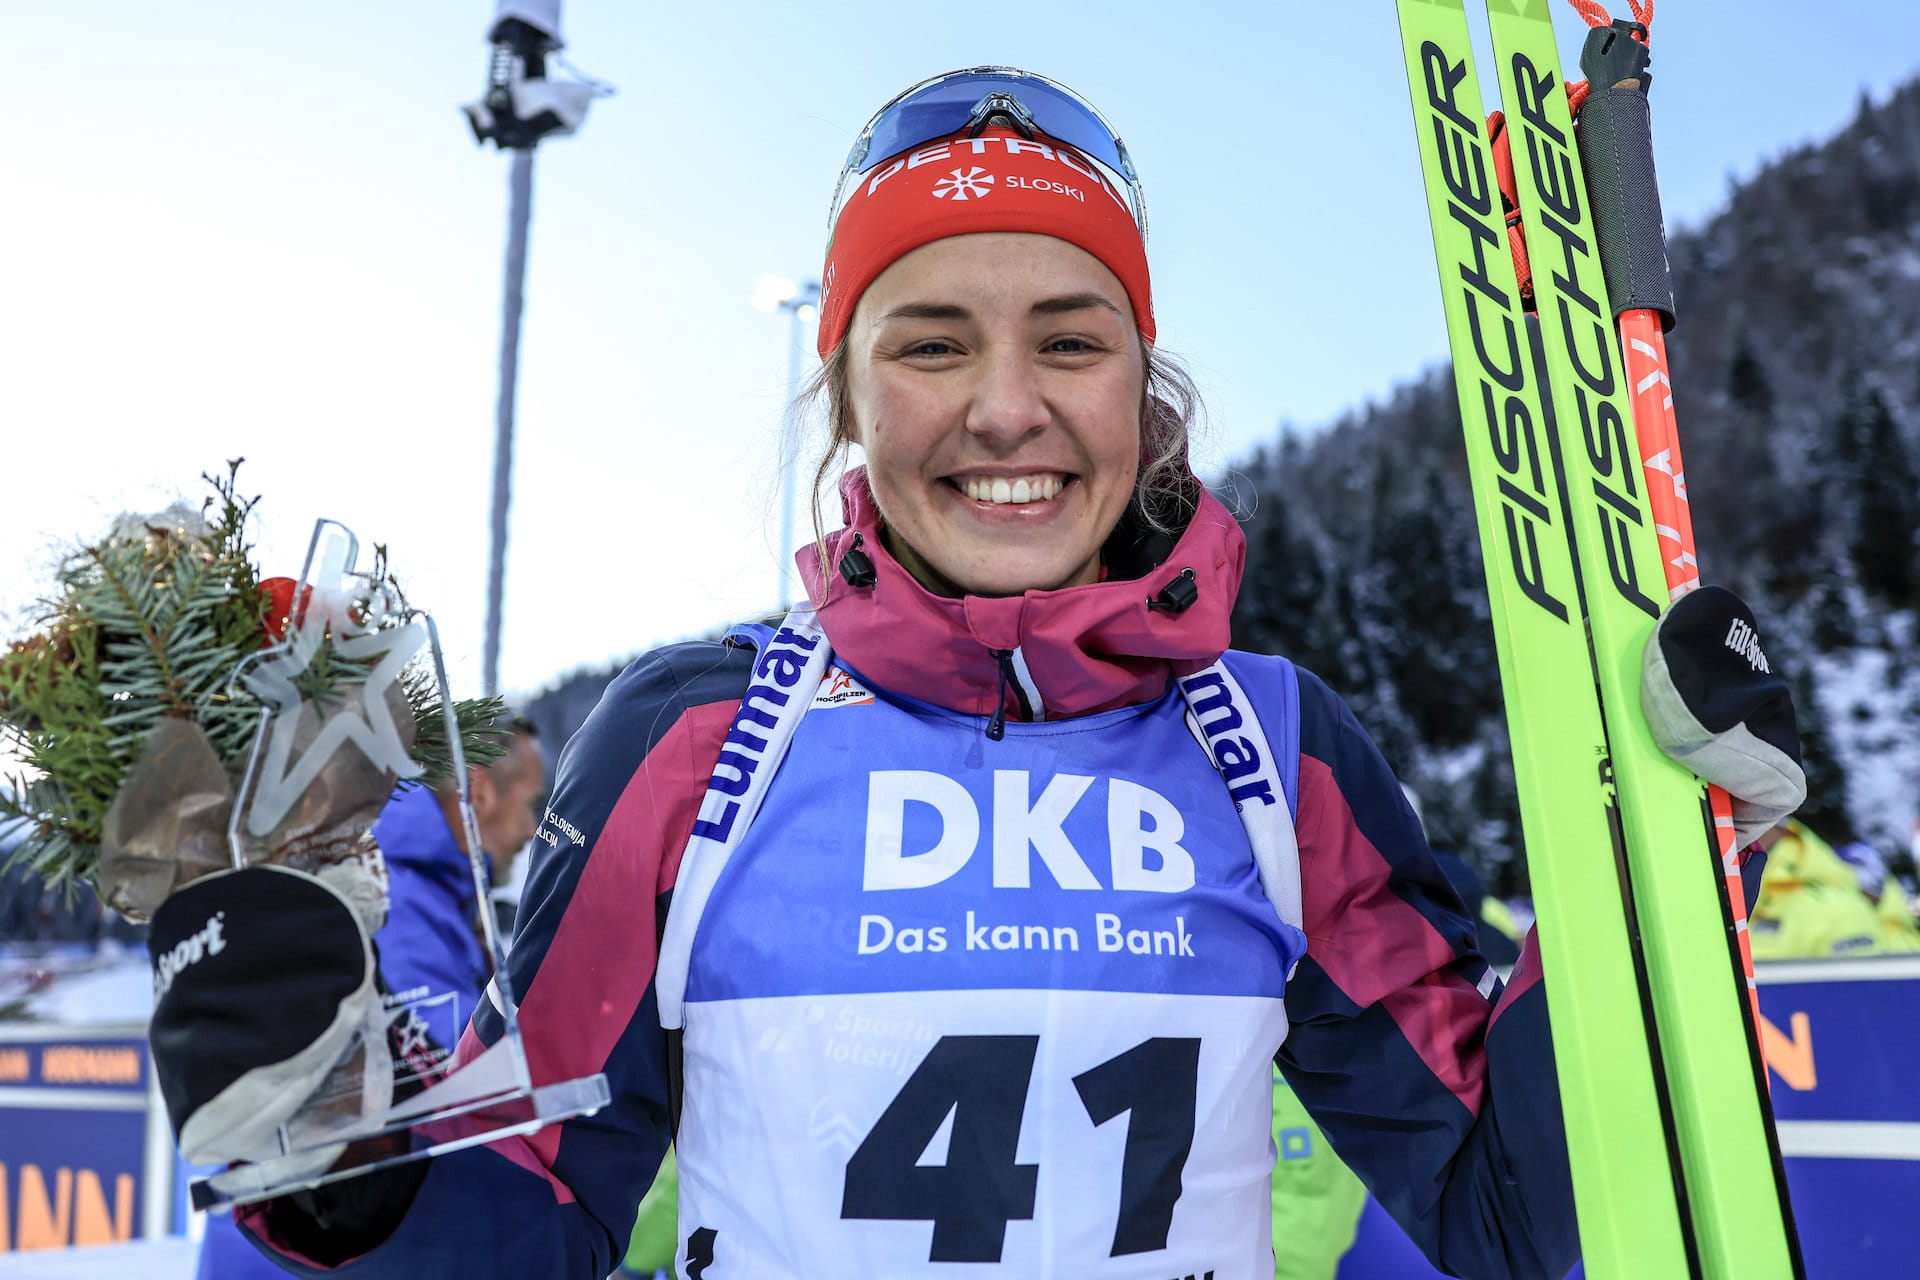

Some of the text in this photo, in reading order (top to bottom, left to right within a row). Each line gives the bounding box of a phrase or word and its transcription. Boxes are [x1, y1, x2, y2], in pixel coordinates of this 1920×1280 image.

[1005, 175, 1085, 203] SLOSKI
[1421, 40, 1570, 625] FISCHER
[1511, 52, 1661, 620] FISCHER
[690, 627, 817, 844] Lumar
[816, 690, 866, 703] HOCHFILZEN
[1182, 671, 1277, 807] mar
[862, 769, 1196, 894] DKB
[857, 915, 948, 955] Das
[966, 911, 1080, 952] kann
[1096, 913, 1196, 958] Bank
[840, 1034, 1203, 1263] 41
